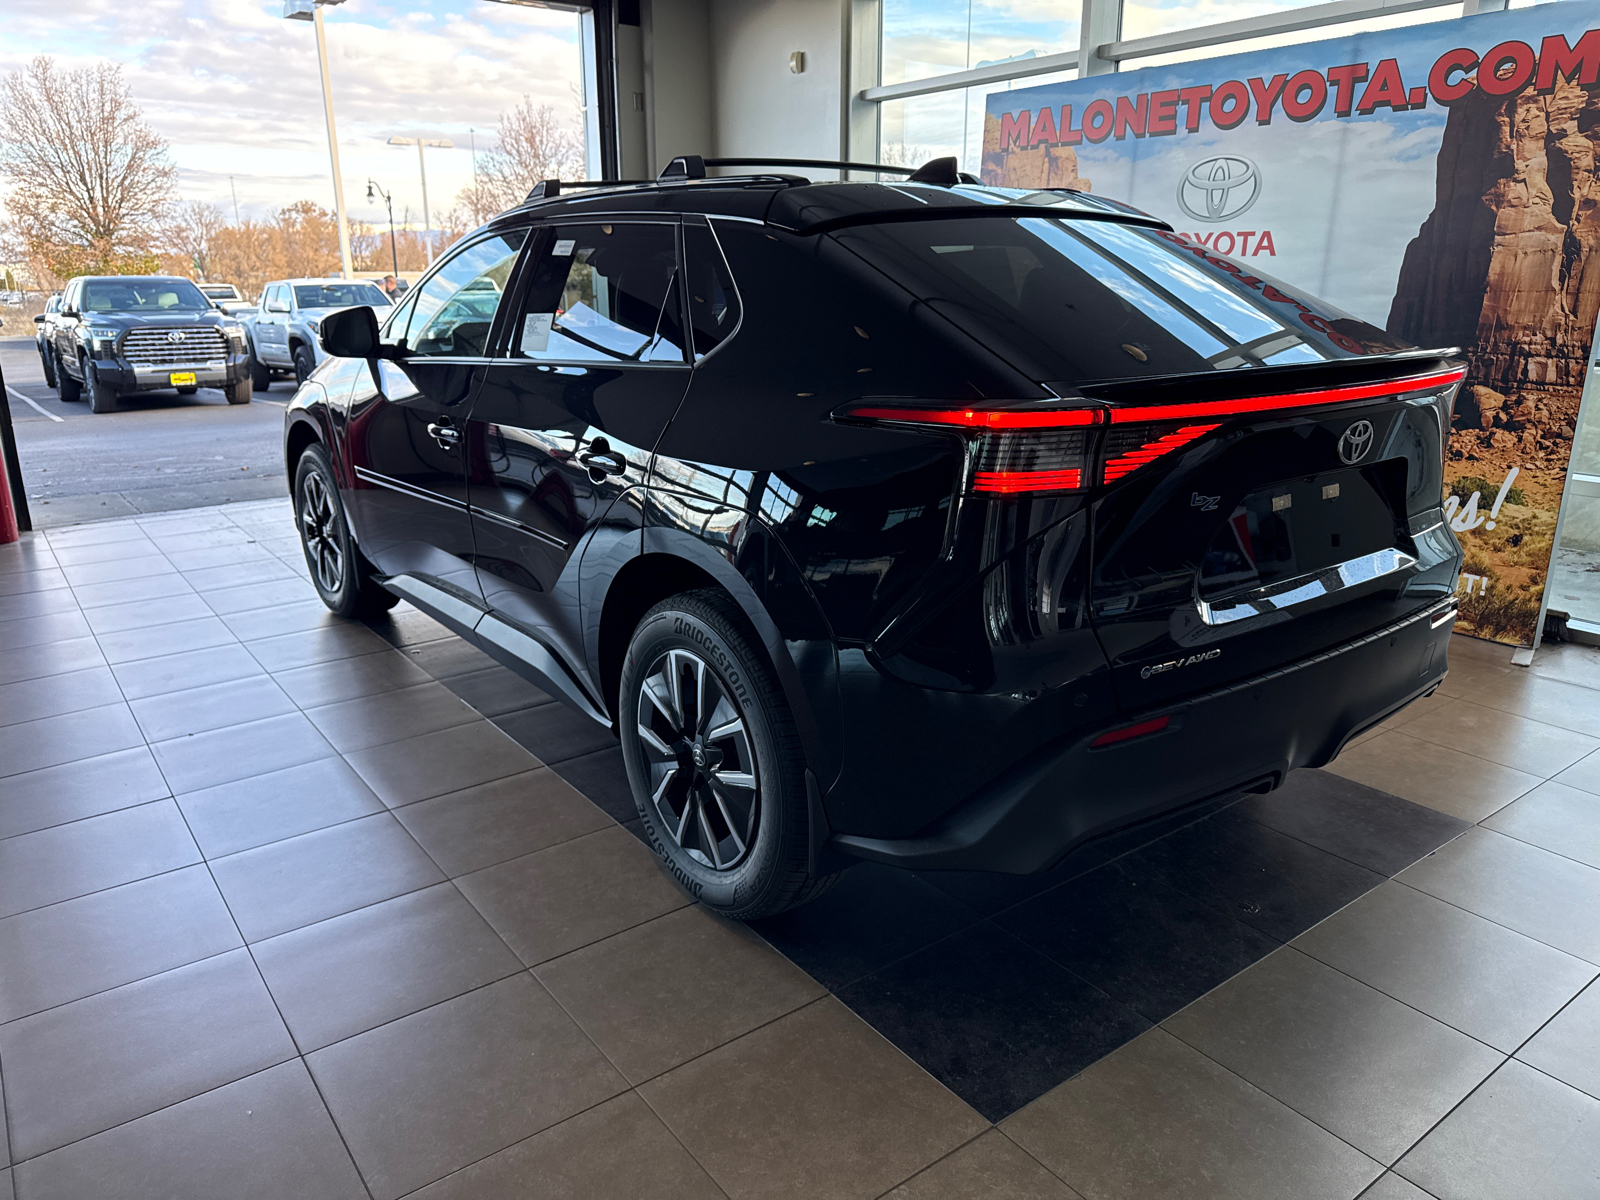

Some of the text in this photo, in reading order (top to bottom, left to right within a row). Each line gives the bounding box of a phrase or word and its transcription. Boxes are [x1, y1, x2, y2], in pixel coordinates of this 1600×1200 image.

[1000, 29, 1600, 151] MALONETOYOTA.COM
[1179, 231, 1277, 257] YOTA
[673, 617, 753, 710] BRIDGESTONE
[1150, 648, 1221, 675] BEV AWD
[638, 803, 703, 899] BRIDGESTONE
